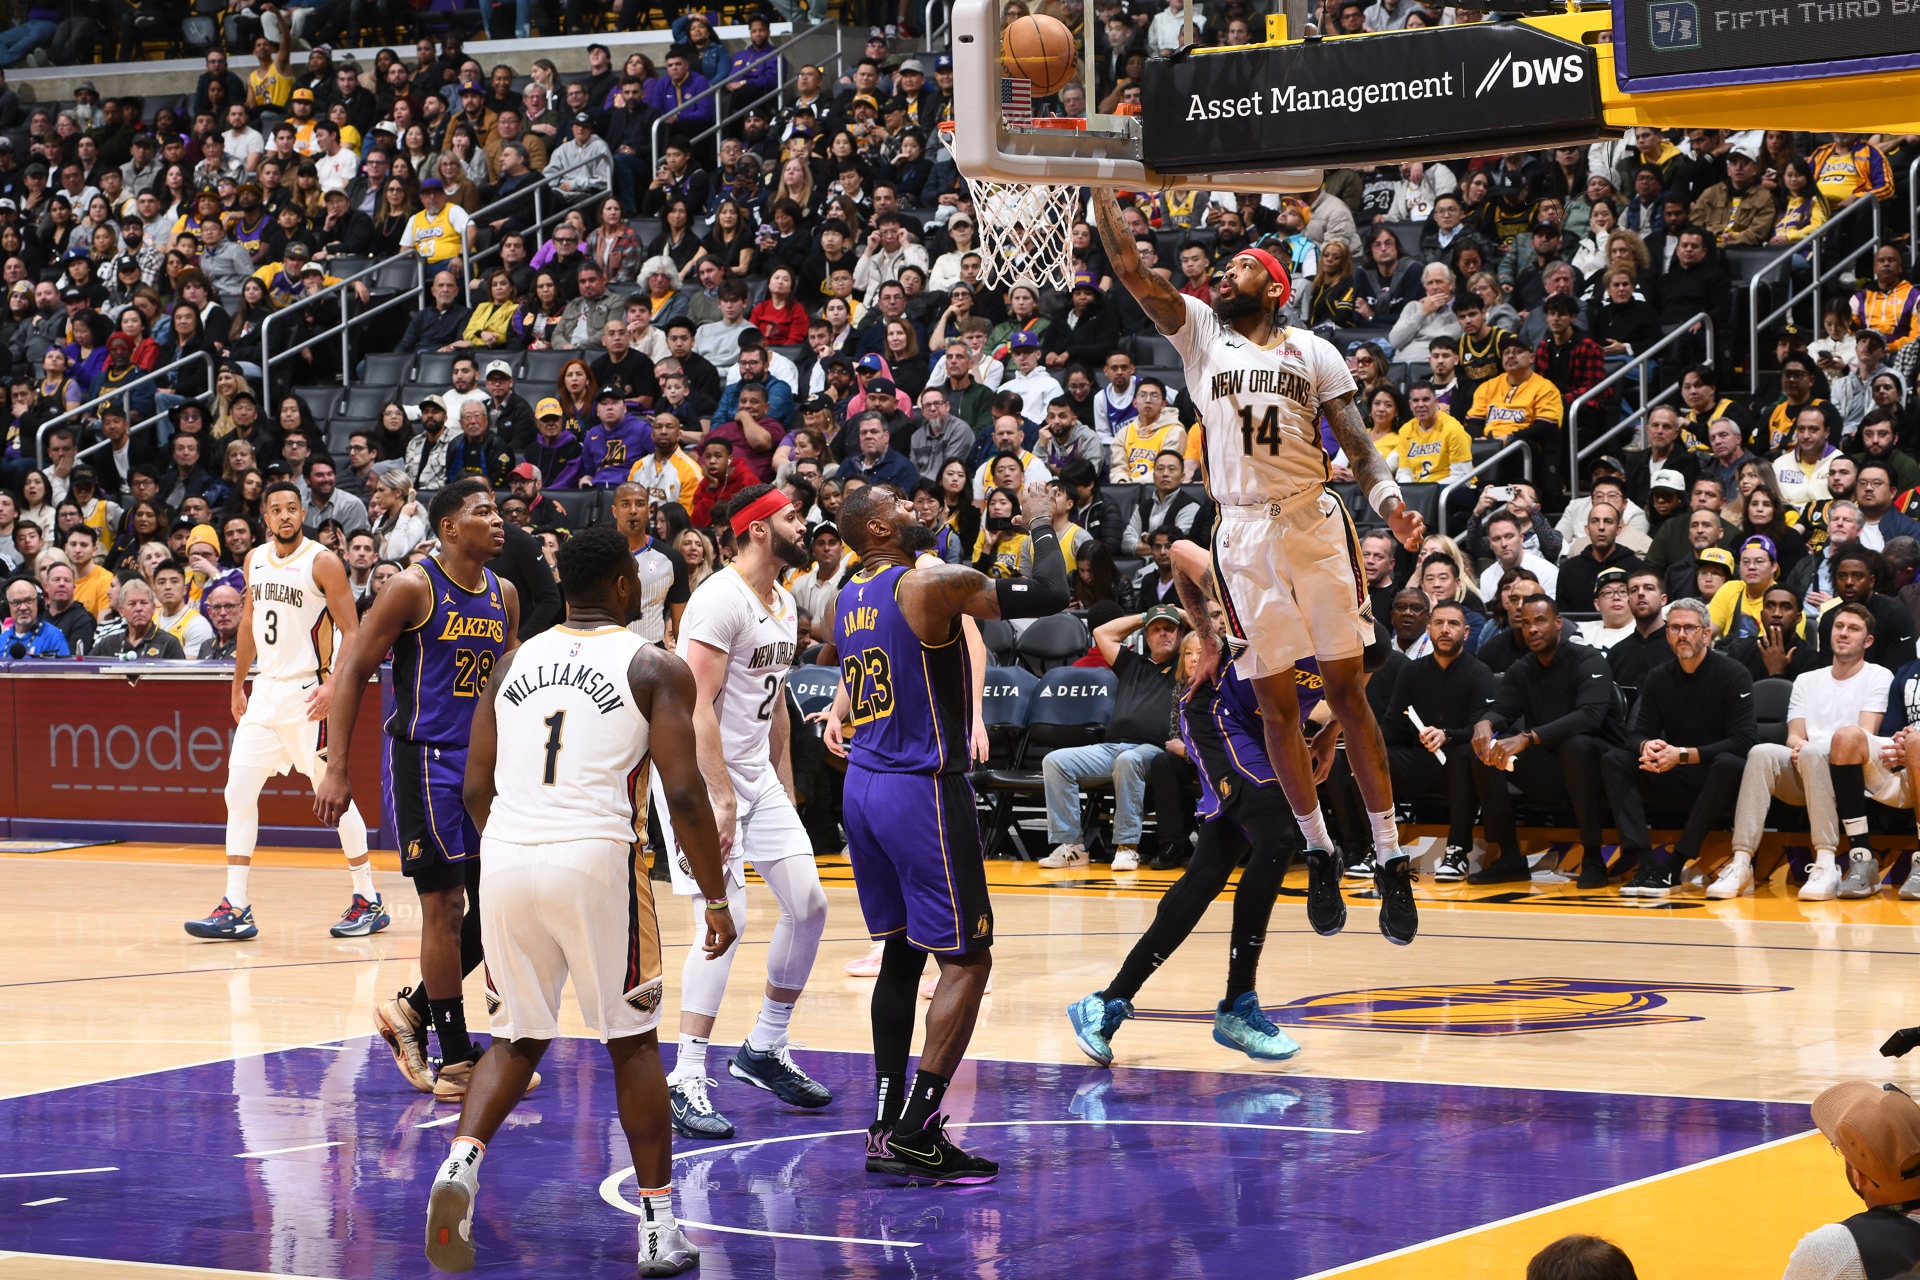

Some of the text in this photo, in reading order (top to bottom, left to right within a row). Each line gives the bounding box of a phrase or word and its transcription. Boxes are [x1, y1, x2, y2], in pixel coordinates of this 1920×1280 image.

[1714, 7, 1790, 32] FIFTH
[1798, 0, 1881, 24] THIRD
[1512, 54, 1584, 89] DWS
[1186, 71, 1453, 121] Asset Management
[1211, 369, 1311, 407] NEW ORLEANS
[1238, 405, 1282, 457] 14
[1487, 405, 1527, 426] LAKERS
[265, 582, 303, 608] ORLEANS
[264, 609, 278, 645] 3
[437, 611, 504, 643] LAKERS
[844, 606, 878, 638] JAMES
[748, 642, 796, 669] NEW ORLE
[453, 648, 496, 698] 28
[503, 663, 625, 714] WILLIAMSON
[843, 646, 895, 727] 23
[1295, 669, 1324, 689] ERS
[797, 683, 838, 697] DELT
[983, 685, 1019, 697] ELTA
[1057, 685, 1108, 697] DELTA
[542, 709, 567, 787] 1
